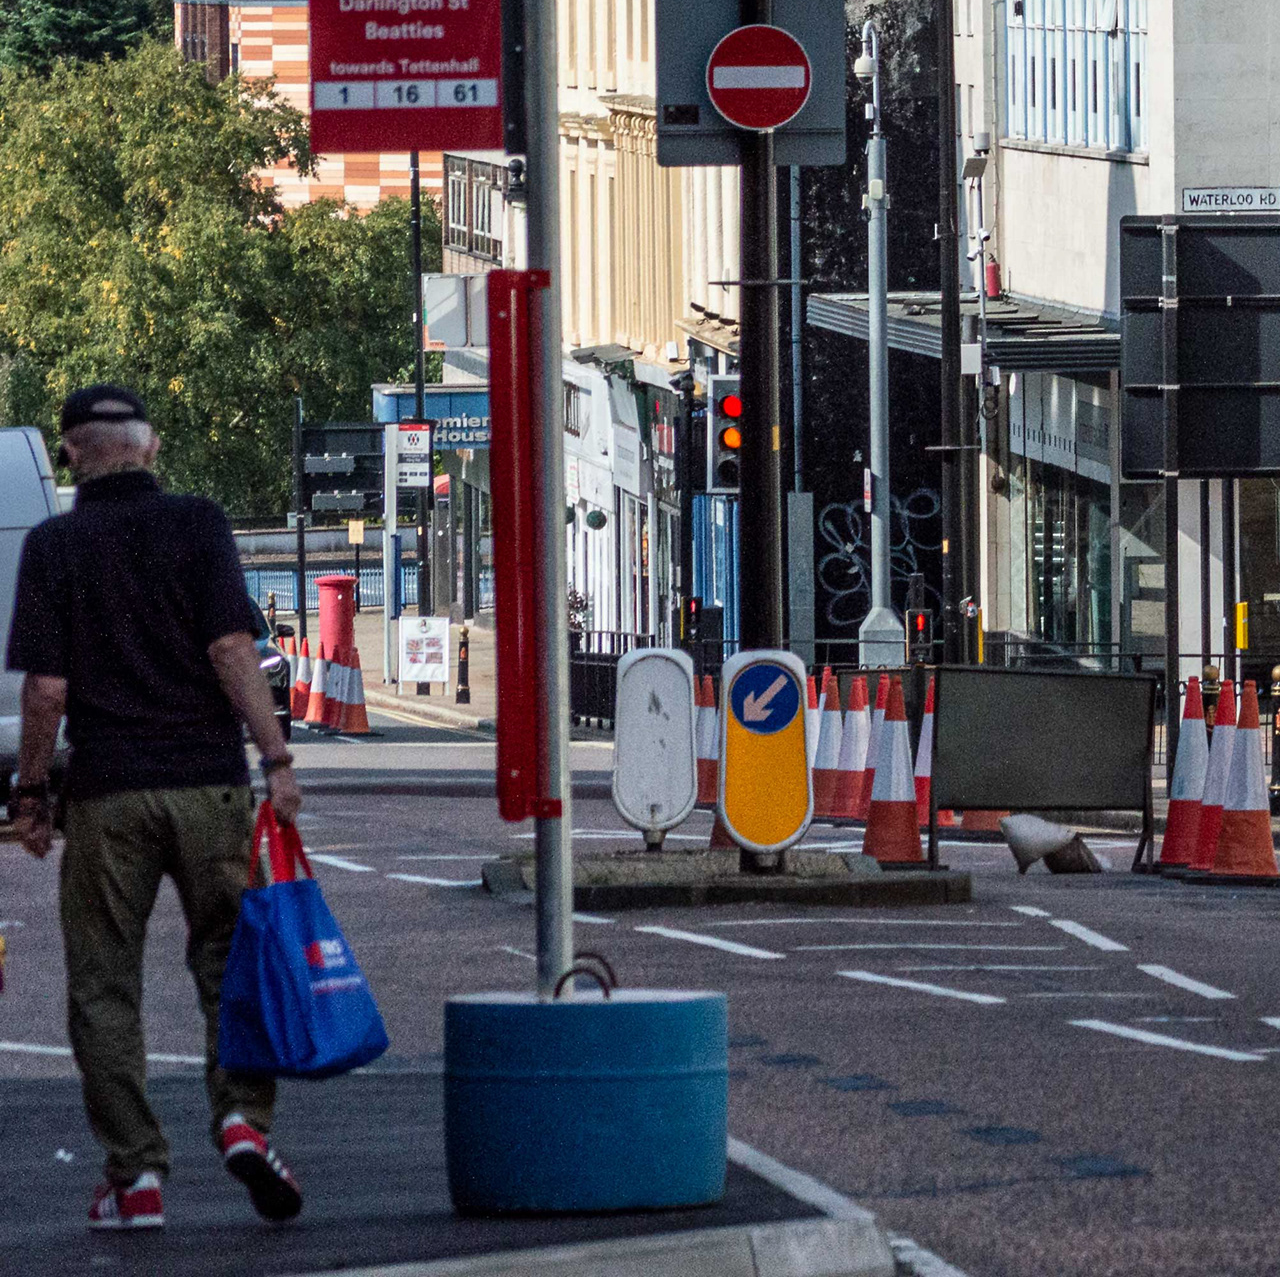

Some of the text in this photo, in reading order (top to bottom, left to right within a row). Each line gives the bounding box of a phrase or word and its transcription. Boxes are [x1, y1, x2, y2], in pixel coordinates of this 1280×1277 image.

[365, 22, 444, 41] Beatties
[330, 59, 395, 75] towards
[339, 83, 478, 104] 1 16 61
[1189, 193, 1277, 206] WATERLOO RD
[433, 428, 491, 443] Hous
